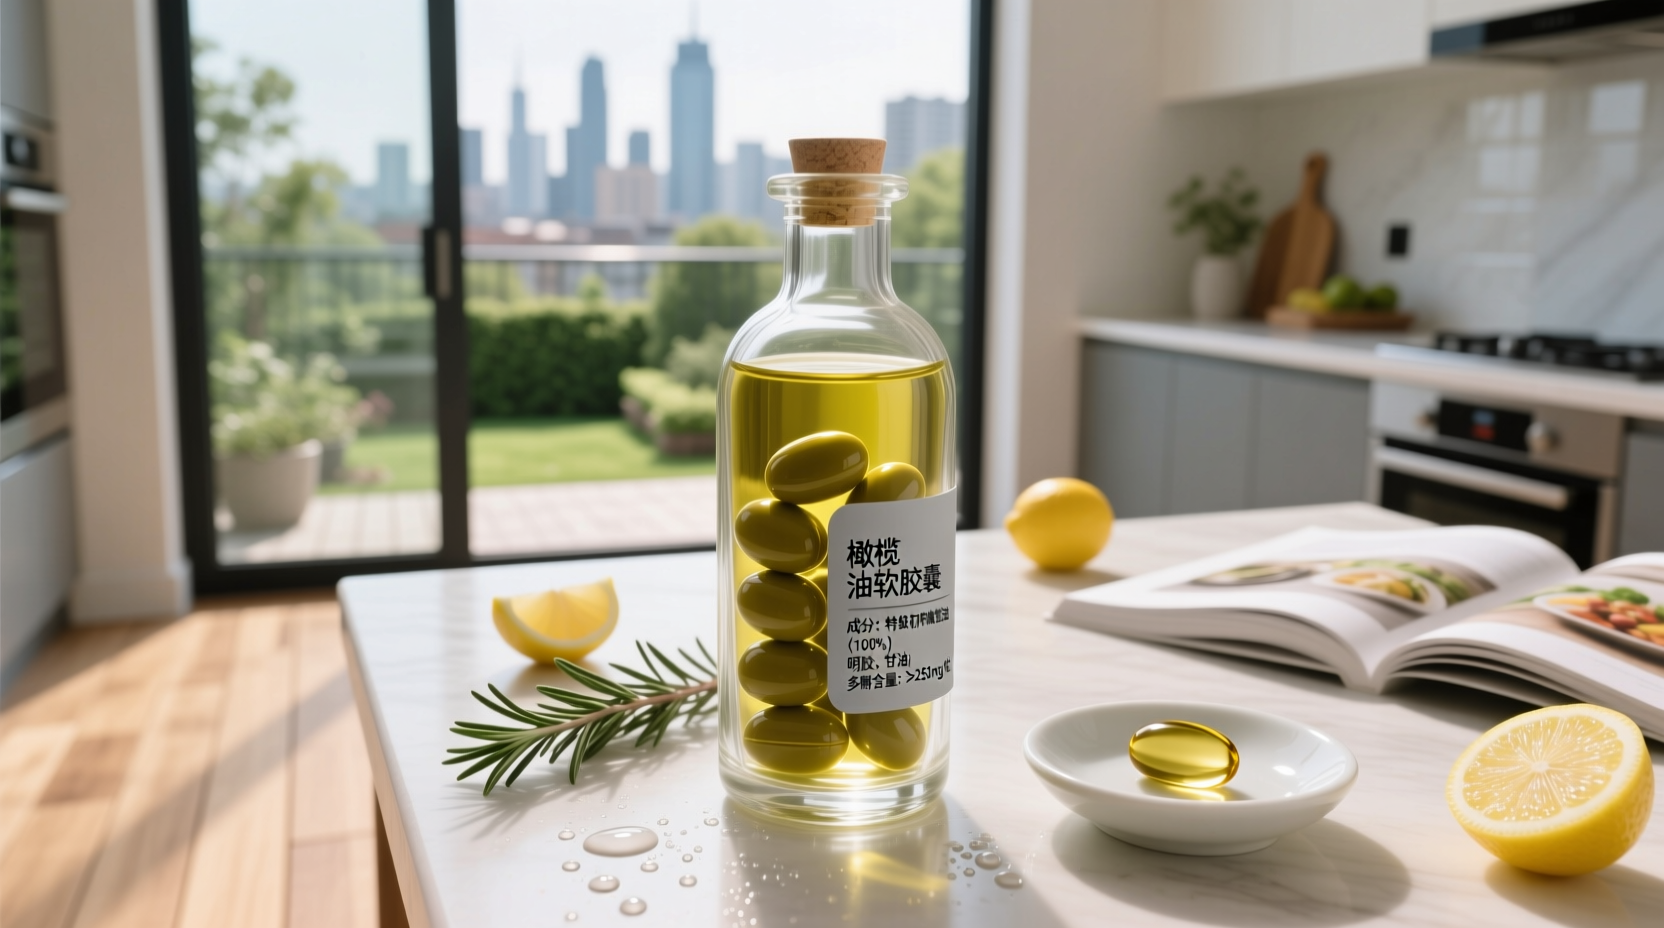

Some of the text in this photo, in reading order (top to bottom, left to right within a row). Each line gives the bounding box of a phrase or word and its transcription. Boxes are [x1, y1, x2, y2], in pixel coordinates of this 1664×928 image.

[847, 537, 901, 568] 橄榄
[847, 564, 941, 599] 油软胶囊
